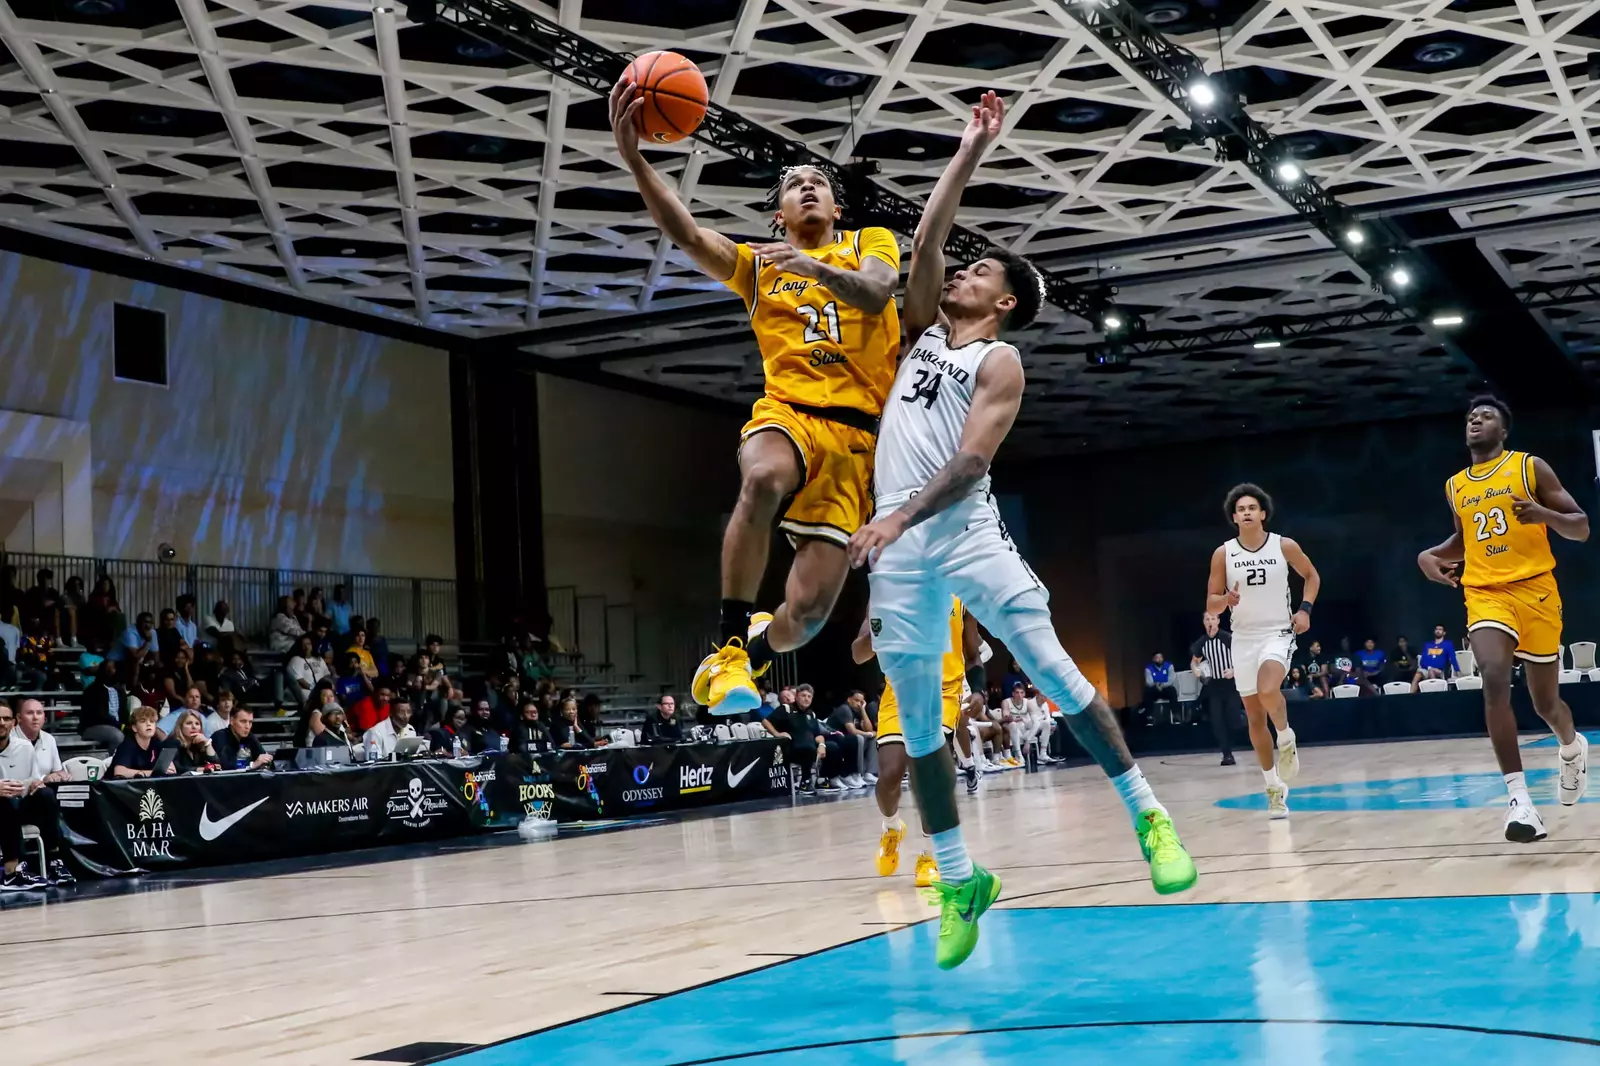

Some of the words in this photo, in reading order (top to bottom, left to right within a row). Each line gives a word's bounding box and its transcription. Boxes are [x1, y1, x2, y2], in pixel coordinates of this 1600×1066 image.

[768, 277, 809, 297] Long
[795, 300, 842, 344] 21
[809, 348, 849, 367] State
[910, 348, 970, 385] OAKLAND
[900, 368, 943, 410] 34
[1461, 496, 1481, 509] Long
[1483, 484, 1513, 500] Beach
[1473, 506, 1508, 542] 23
[1485, 543, 1510, 557] State
[1234, 558, 1277, 569] OAKLAND
[1246, 568, 1266, 586] 23
[680, 763, 714, 788] Hertz
[518, 783, 555, 802] HOOPS
[622, 787, 664, 802] ODYSSEY
[306, 799, 350, 815] MAKERS
[352, 797, 369, 811] AIR
[386, 800, 410, 815] Pirate
[126, 822, 175, 839] BAHA
[133, 840, 178, 859] MAR
